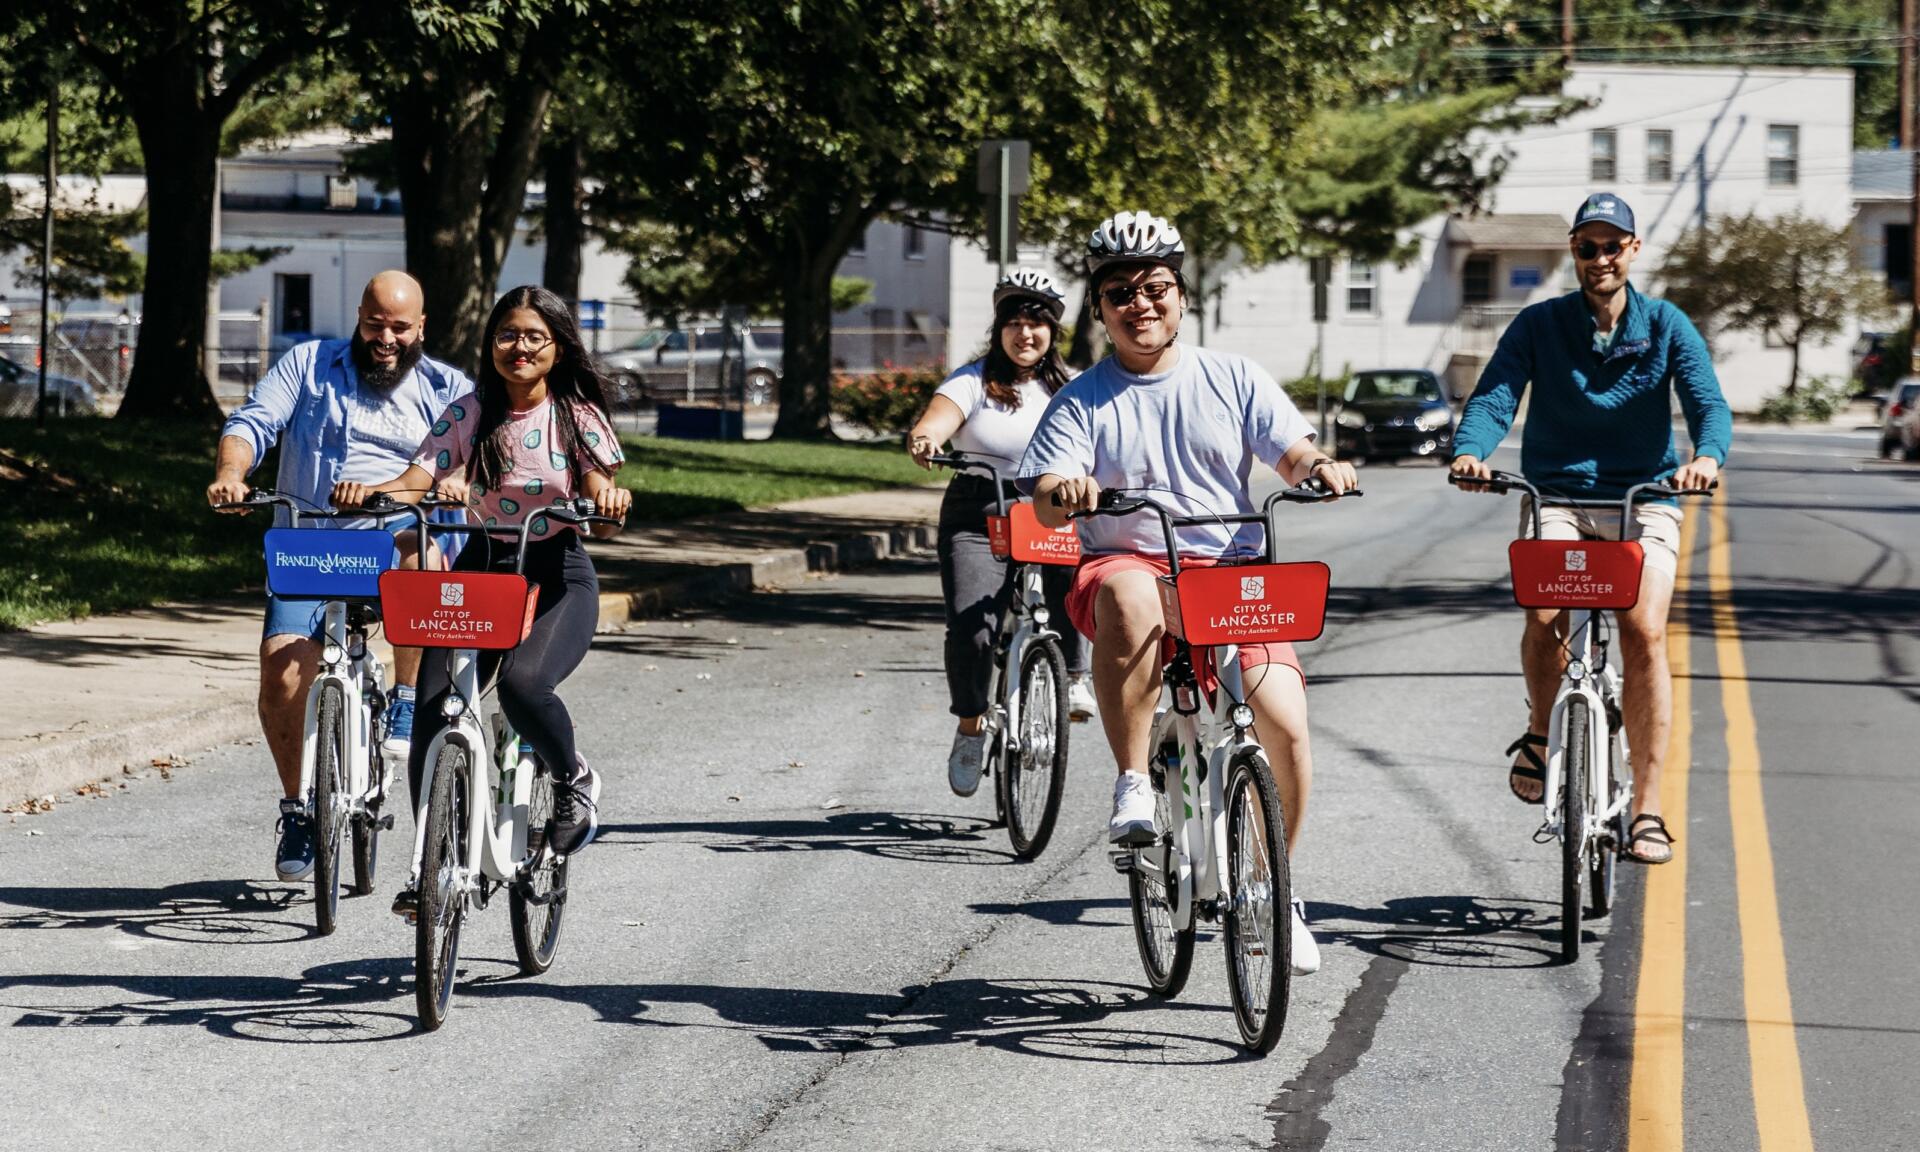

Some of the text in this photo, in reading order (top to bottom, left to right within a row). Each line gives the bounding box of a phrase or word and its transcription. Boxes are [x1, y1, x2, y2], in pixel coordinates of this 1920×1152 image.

[1030, 541, 1080, 553] LANCAST
[1538, 583, 1613, 593] LANCASTER
[433, 610, 455, 618] CITY
[1233, 604, 1272, 614] CITY OF
[1210, 613, 1295, 627] LANCASTER
[411, 619, 493, 632] LANCASTER
[433, 632, 446, 640] City
[1248, 627, 1279, 635] Authentic
